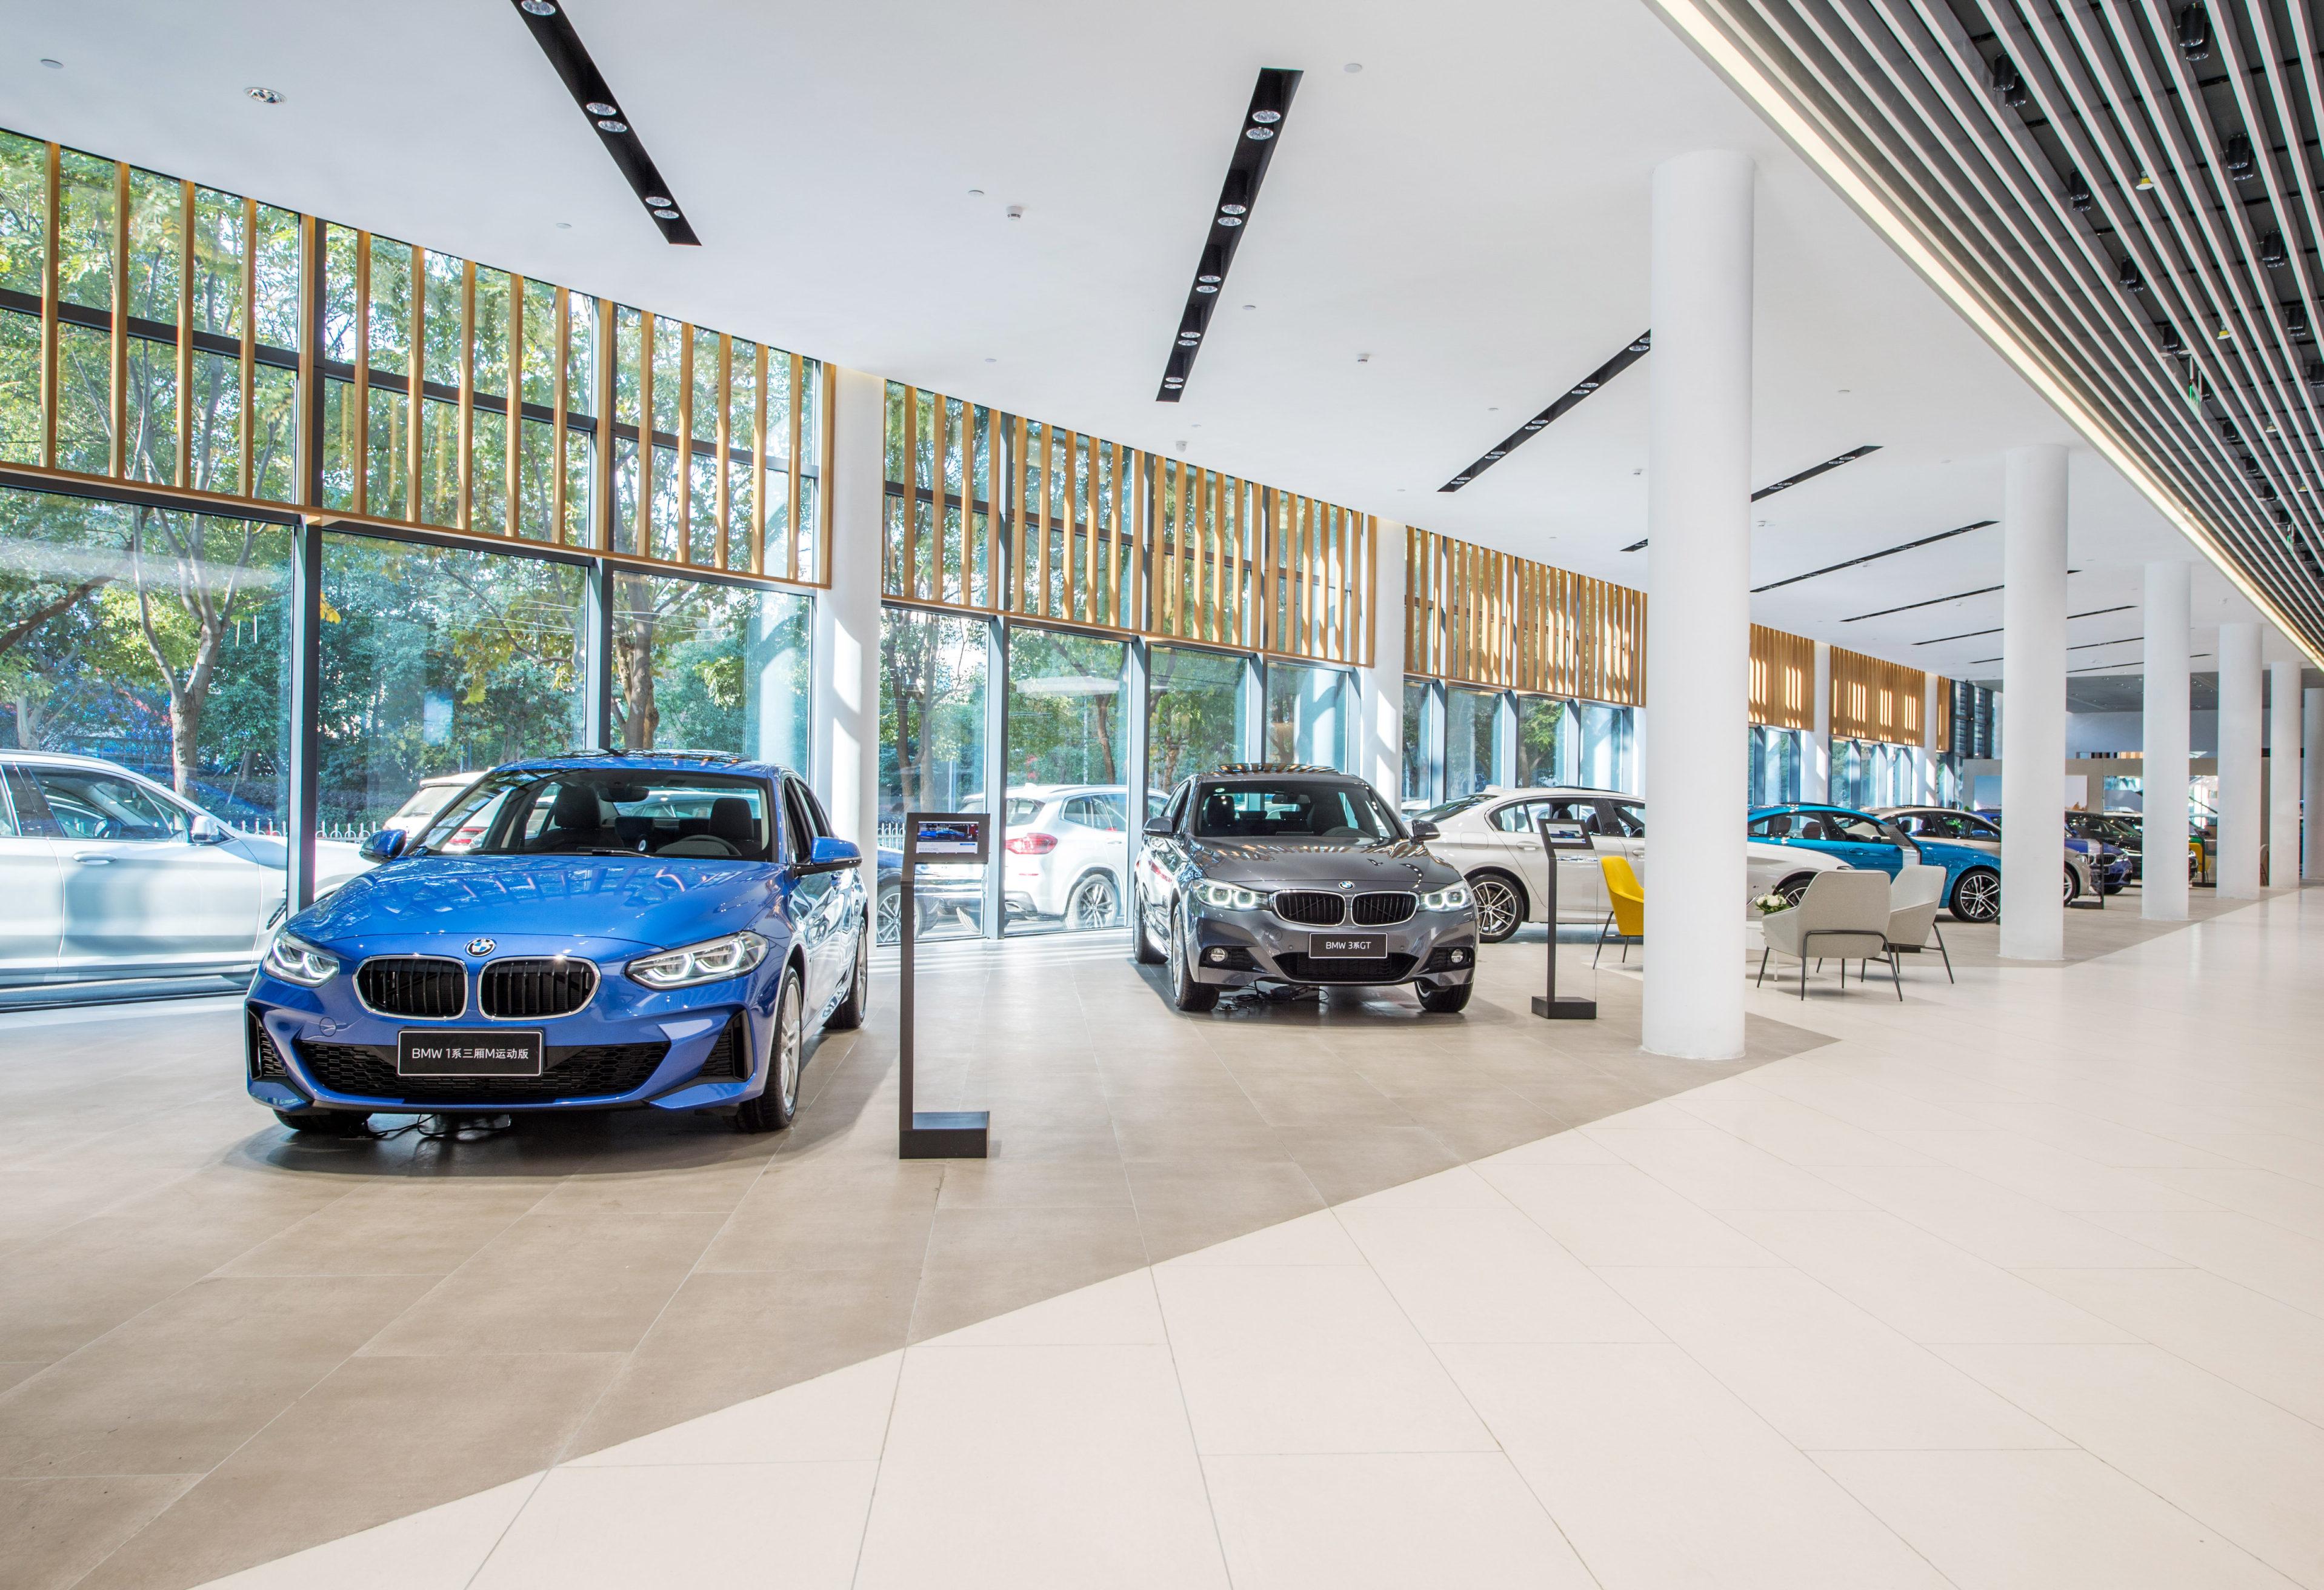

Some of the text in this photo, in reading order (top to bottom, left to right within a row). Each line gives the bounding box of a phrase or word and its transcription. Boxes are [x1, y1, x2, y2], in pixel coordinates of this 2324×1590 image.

[1325, 941, 1371, 950] BMW 3系GT
[412, 1048, 529, 1059] BMW 1系三厢M运动版
